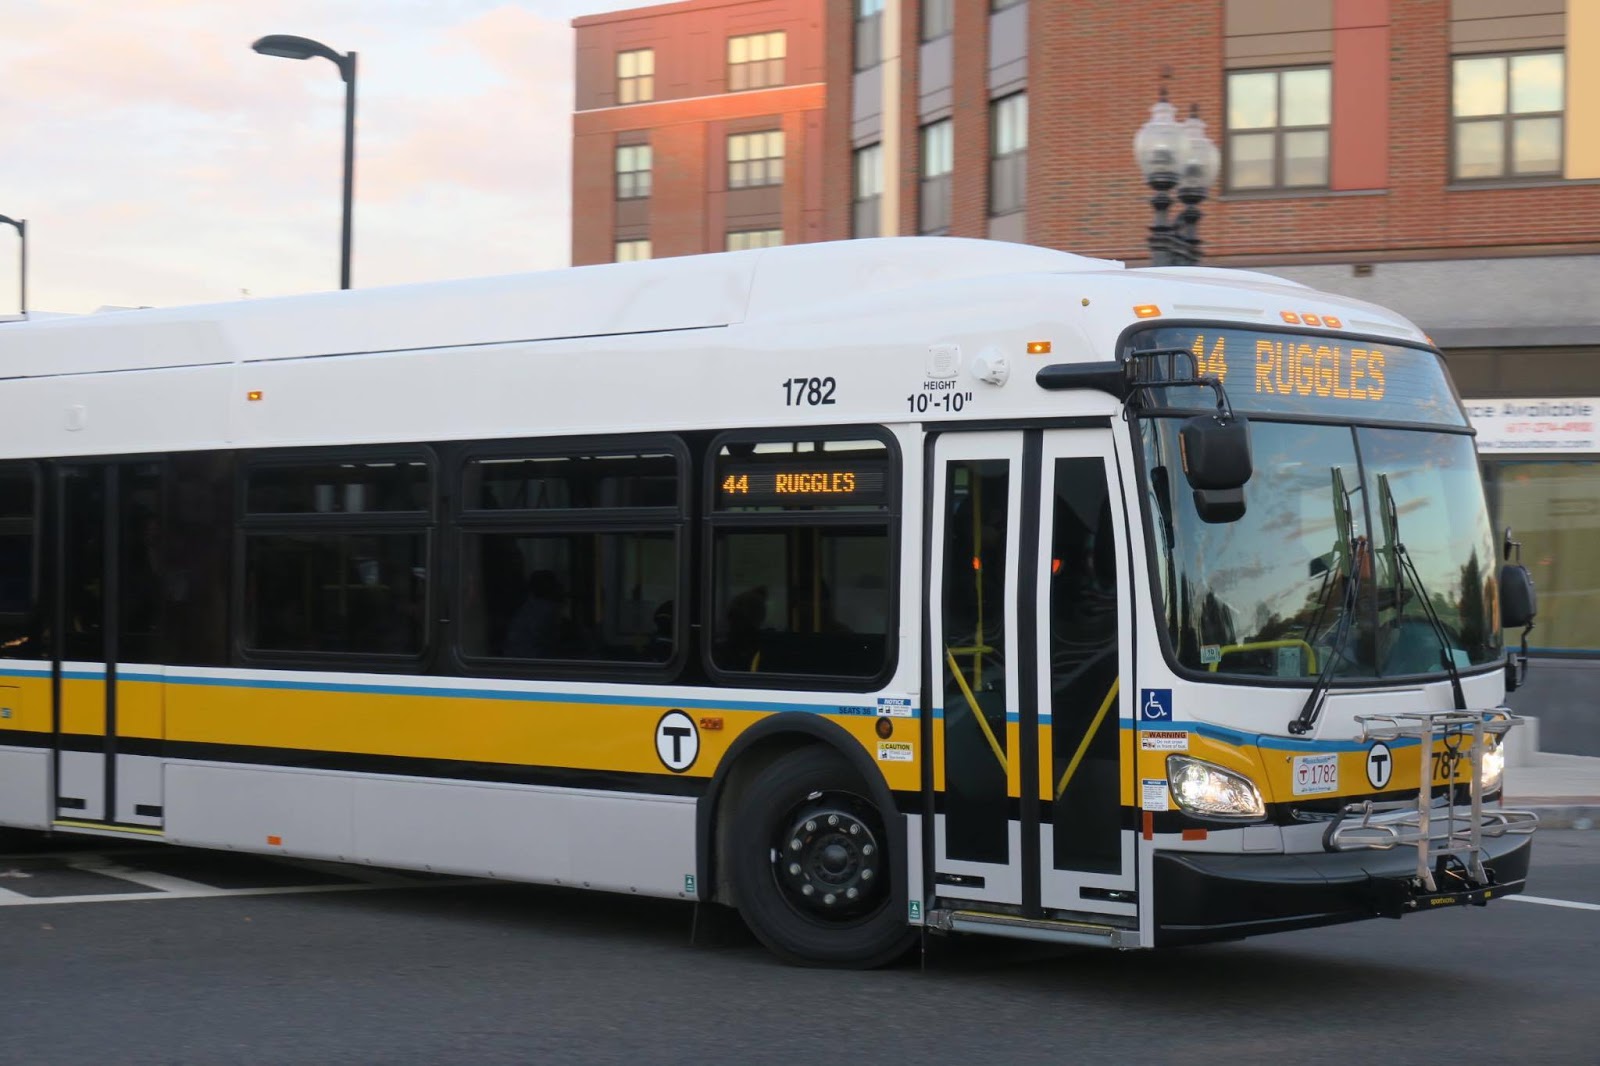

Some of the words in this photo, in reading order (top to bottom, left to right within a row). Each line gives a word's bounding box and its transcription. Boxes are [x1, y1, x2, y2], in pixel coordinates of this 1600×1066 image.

[1256, 340, 1386, 400] RUGGLES
[783, 376, 836, 406] 1782
[923, 380, 957, 390] HEIGHT
[907, 392, 972, 413] 10'-10"
[1502, 402, 1593, 418] Available
[723, 475, 749, 494] 44
[775, 473, 855, 493] RUGGLES
[839, 706, 860, 715] SEATS
[884, 698, 904, 706] NOTICE
[663, 727, 691, 762] T
[1149, 731, 1186, 739] WARNING
[885, 743, 910, 751] CAUTION
[1311, 763, 1337, 785] 1782
[1371, 754, 1388, 782] T
